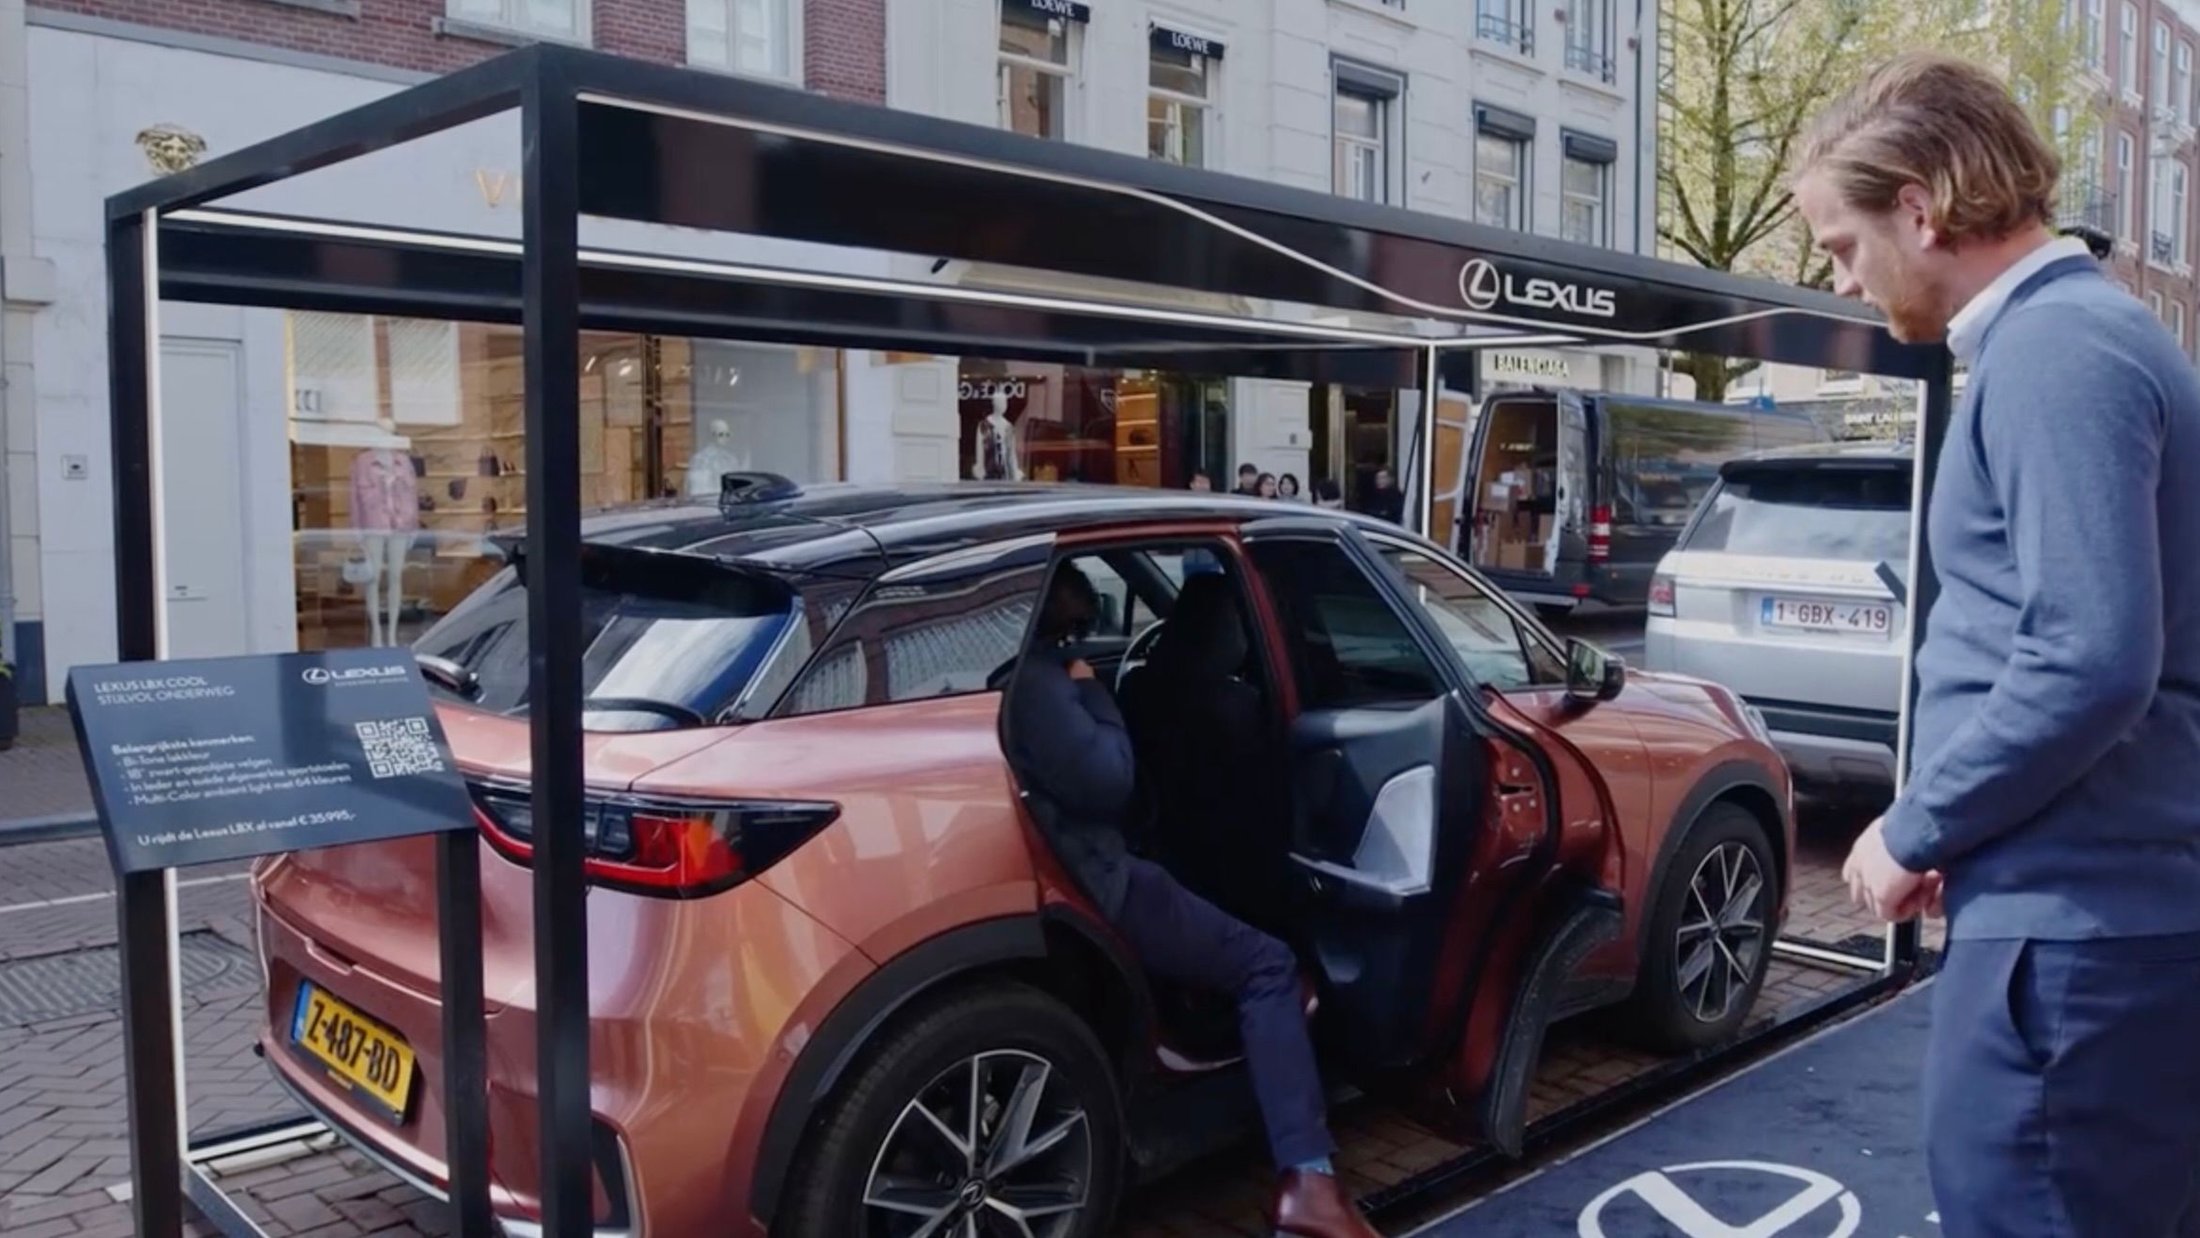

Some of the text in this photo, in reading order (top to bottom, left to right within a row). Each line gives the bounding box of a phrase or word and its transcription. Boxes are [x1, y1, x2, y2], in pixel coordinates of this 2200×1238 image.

[1172, 32, 1209, 54] LOEWE
[1504, 274, 1616, 317] LEXUS
[1494, 354, 1570, 377] BALENCIAGA
[331, 666, 406, 680] LEXUS
[94, 676, 207, 693] LEXUS LBX COOL
[156, 686, 235, 700] ONDERWEG
[248, 782, 272, 794] light
[295, 777, 311, 788] 64
[311, 775, 353, 785] kleuren
[137, 835, 150, 846] U
[178, 830, 193, 841] de
[193, 828, 229, 840] Lexus
[229, 821, 255, 835] LBX
[307, 999, 401, 1092] Z-487-BD
